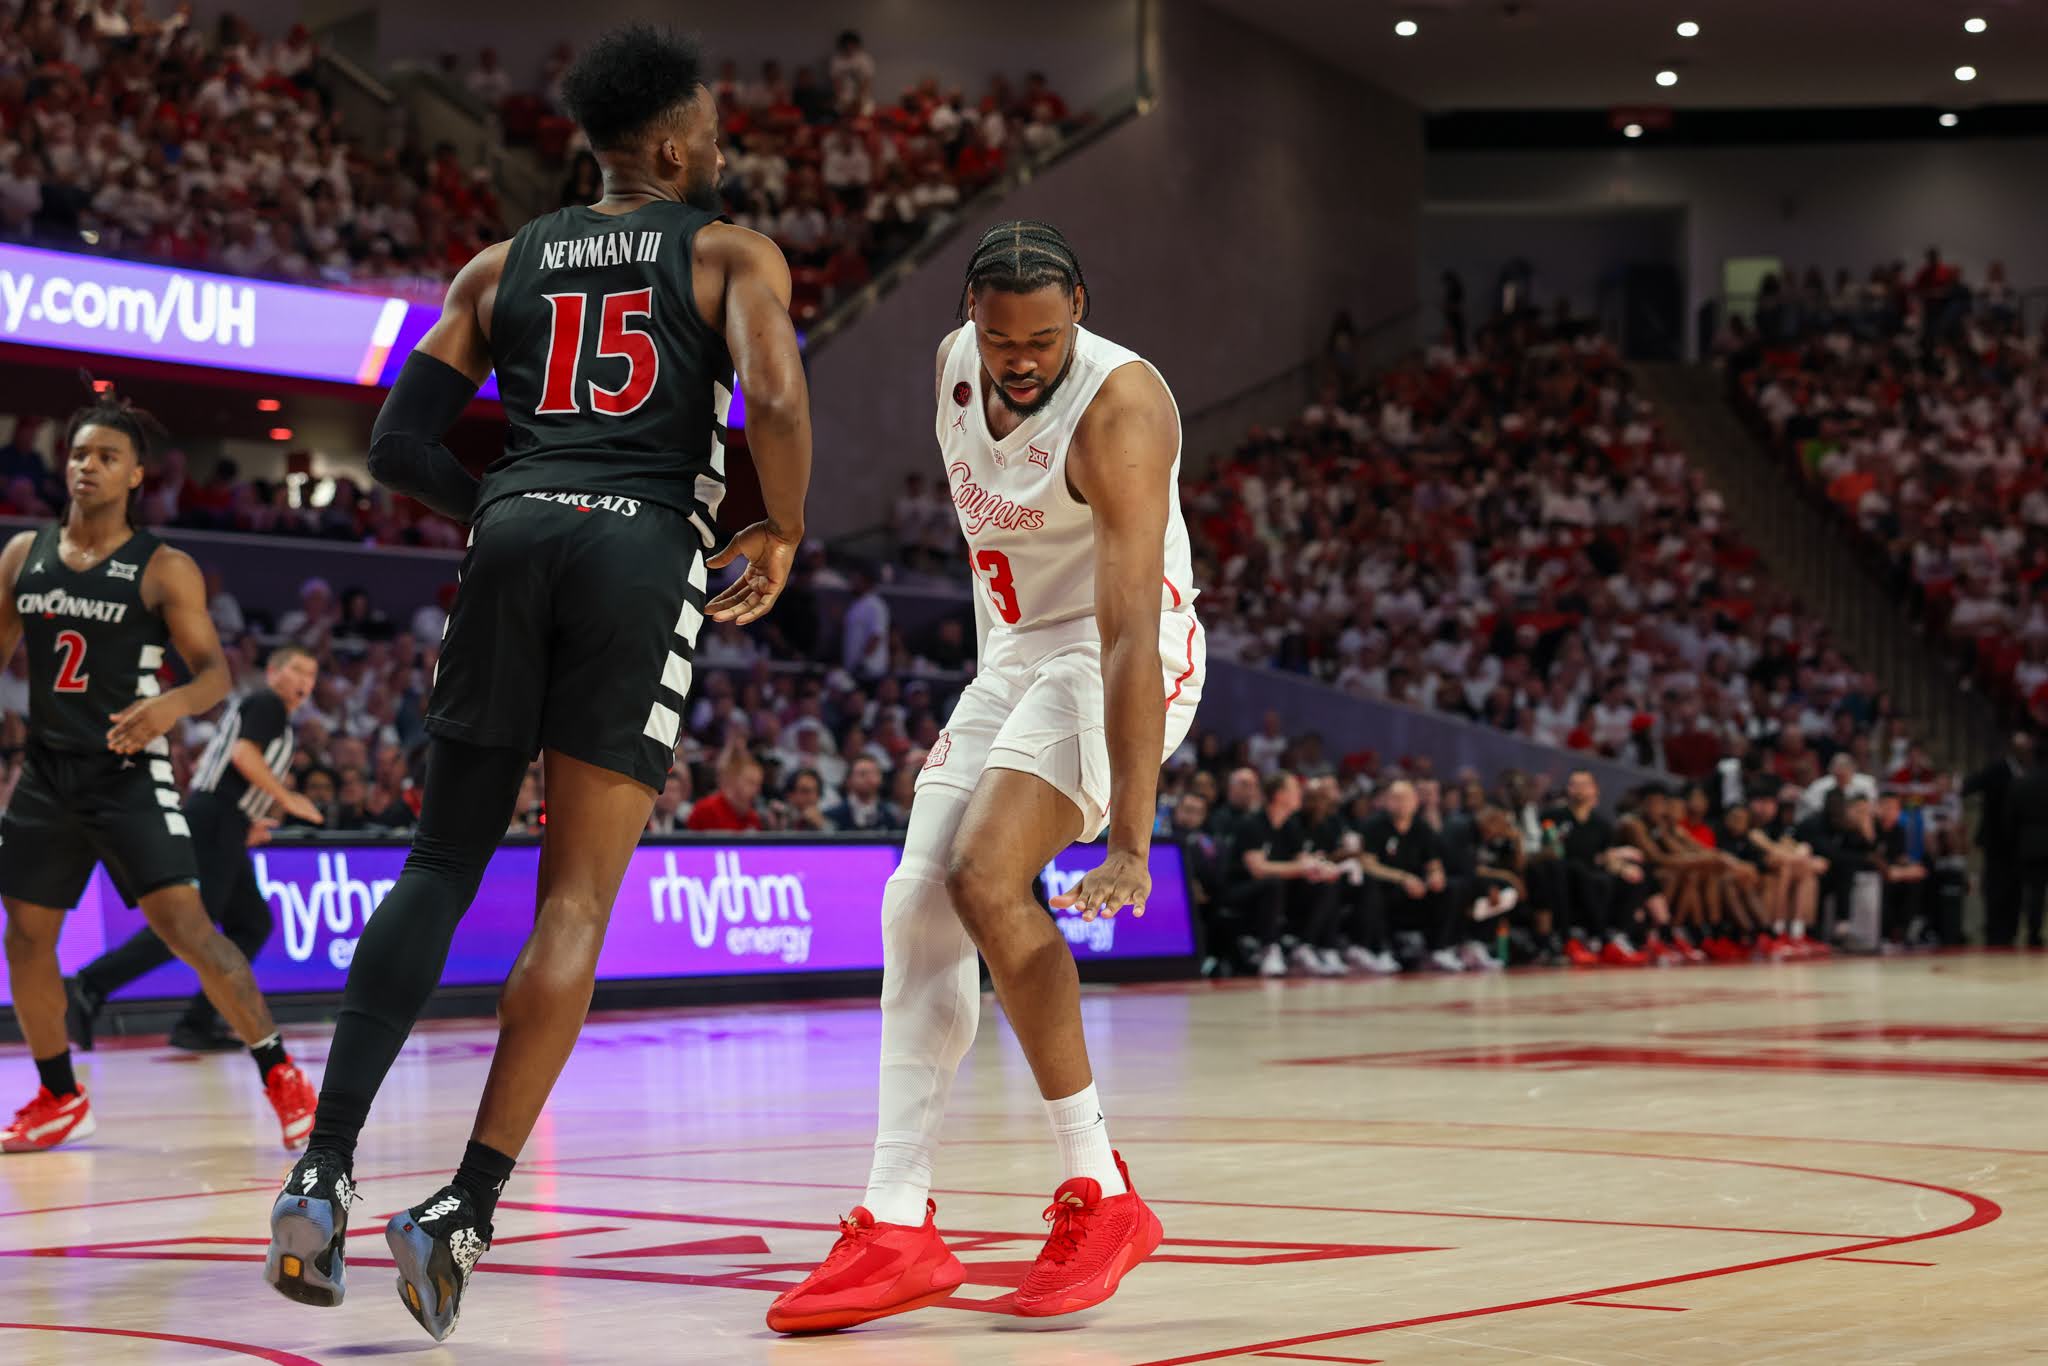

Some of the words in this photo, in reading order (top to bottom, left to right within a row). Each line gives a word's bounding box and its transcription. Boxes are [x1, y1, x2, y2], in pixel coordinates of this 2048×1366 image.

[539, 231, 634, 270] NEWMAN
[636, 231, 663, 262] III
[535, 286, 660, 416] 15
[522, 492, 641, 516] ARCATS
[949, 461, 1045, 535] Cougars
[17, 588, 128, 623] CINCINNATI
[968, 545, 1022, 625] 3
[54, 629, 89, 693] 2
[253, 852, 400, 961] hyth
[649, 850, 812, 948] rhythm
